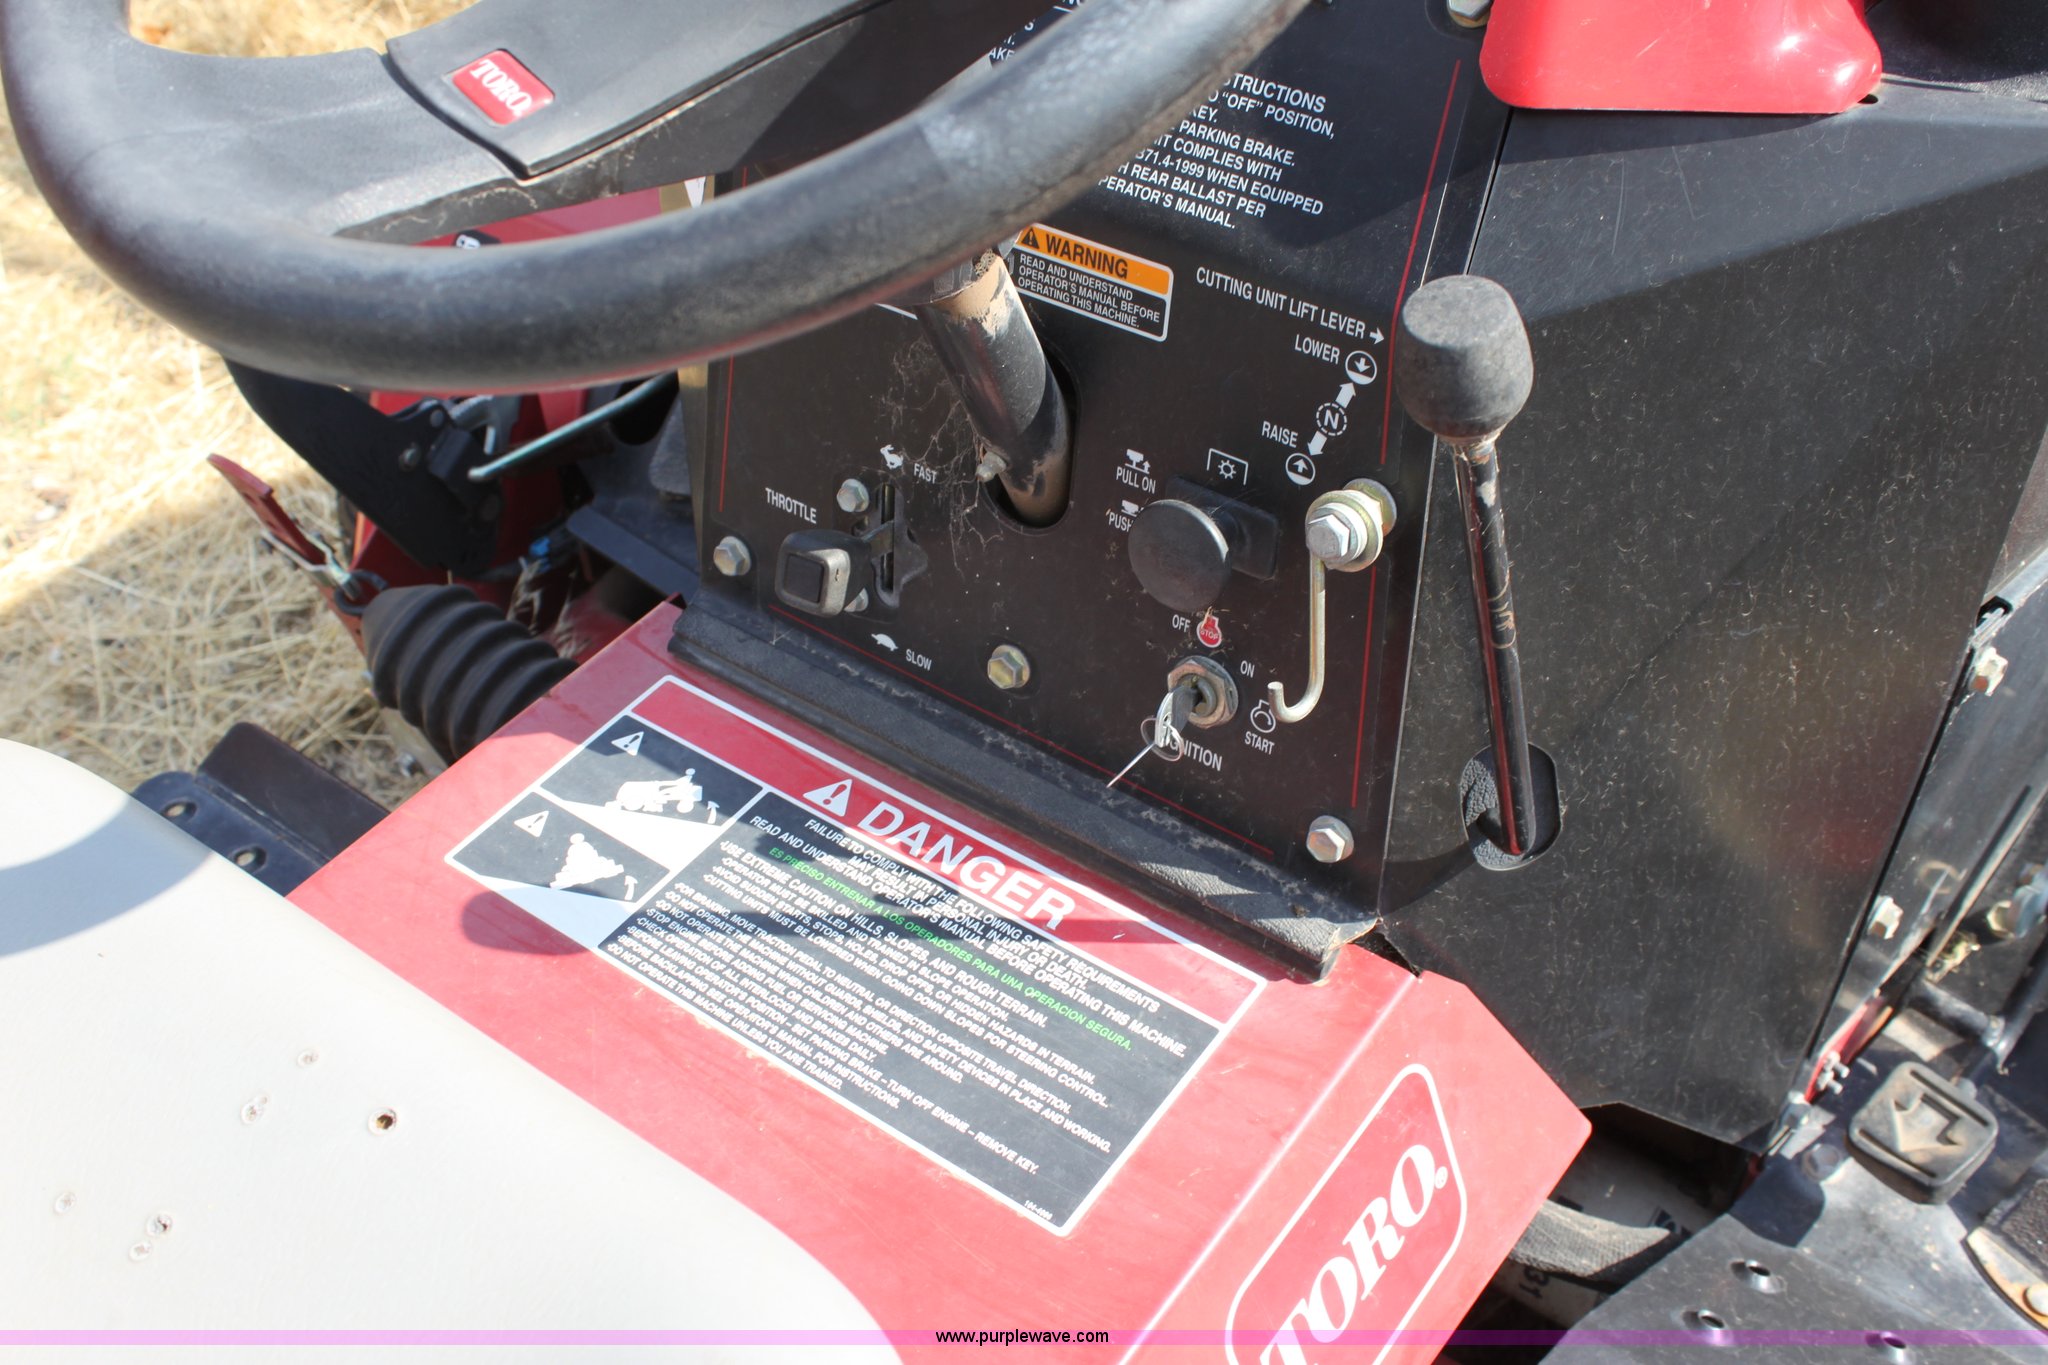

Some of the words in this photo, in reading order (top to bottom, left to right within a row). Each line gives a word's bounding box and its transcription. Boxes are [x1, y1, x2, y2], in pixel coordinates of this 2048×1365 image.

[470, 59, 532, 116] TORO
[1179, 120, 1241, 150] PARKING
[1243, 138, 1295, 166] BRAKE.
[1264, 104, 1334, 140] POSITION,
[1173, 137, 1244, 170] COMPLIES
[1246, 158, 1282, 182] WITH
[1130, 164, 1169, 187] REAR
[1171, 176, 1236, 207] BALLAST
[1236, 197, 1266, 218] PER
[1175, 197, 1236, 229] MANUAL.
[1206, 166, 1249, 192] WHEN
[1250, 181, 1324, 215] EQUIPPED
[1020, 253, 1045, 270] READ
[1047, 263, 1067, 278] AND
[1069, 271, 1133, 301] UNDERSTAND
[1045, 233, 1128, 279] WARNING
[1018, 276, 1070, 303] OPERATING
[1071, 295, 1092, 311] THIS
[1093, 302, 1140, 328] MACHINE.
[1019, 265, 1077, 292] OPERATOR'S
[1078, 286, 1118, 309] MANUAL
[1120, 301, 1160, 323] BEFORE
[1196, 266, 1252, 300] CUTTING
[1255, 286, 1287, 311] UNIT
[1288, 298, 1318, 322] LIFT
[1320, 308, 1366, 339] LEVER
[1294, 334, 1340, 365] LOWER
[1261, 421, 1298, 448] RAISE
[1323, 409, 1339, 430] N
[914, 463, 938, 484] FAST
[1116, 466, 1139, 488] PULL
[1141, 476, 1156, 494] ON
[765, 487, 817, 524] THROTTLE
[1172, 614, 1191, 633] OFF
[906, 649, 932, 671] SLOW
[1240, 660, 1255, 678] ON
[1245, 731, 1275, 755] START
[857, 801, 1075, 931] DANGER
[740, 851, 791, 884] EXTREME
[787, 877, 837, 910] CAUTION
[832, 902, 853, 919] ON
[850, 912, 886, 937] HILLS,
[883, 930, 932, 963] SLOPES,
[929, 955, 957, 976] AND
[953, 969, 998, 999] ROUGH
[994, 991, 1049, 1028] TERRAIN.
[749, 815, 781, 837] READ
[778, 831, 804, 849] AND
[801, 843, 873, 887] UNDERSTAND
[870, 880, 941, 923] OPERATOR'S
[938, 917, 989, 949] MANUAL
[985, 942, 1035, 975] BEFORE
[1033, 968, 1102, 1011] OPERATING
[1099, 1003, 1130, 1026] THIS
[1127, 1019, 1188, 1058] MACHINE.
[768, 882, 795, 901] MUST
[793, 896, 809, 909] BE
[807, 904, 847, 930] SKILLED
[846, 926, 868, 942] AND
[866, 936, 908, 965] TRAINED
[906, 959, 919, 971] IN
[918, 965, 952, 989] SLOPE
[804, 818, 850, 847] FAILURE
[845, 840, 865, 855] TO
[861, 848, 907, 878] COMPLY
[905, 871, 935, 893] WITH
[931, 885, 958, 905] THE
[954, 898, 1022, 940] FOLLOWING
[1021, 933, 1068, 964] SAFETY
[1065, 957, 1160, 1013] REQUIREMENTS
[848, 855, 873, 873] MAY
[871, 867, 916, 896] RESULT
[912, 889, 928, 903] IN
[925, 896, 987, 934] PERSONAL
[985, 928, 1028, 957] INJURY
[1026, 950, 1047, 967] OR
[1045, 960, 1089, 990] DEATH.
[738, 879, 778, 906] SUDDEN
[878, 957, 908, 979] DROP
[934, 989, 952, 1004] OR
[950, 998, 989, 1025] HIDDEN
[987, 1019, 1037, 1052] HAZARDS
[1035, 1046, 1050, 1059] IN
[768, 846, 783, 859] ES
[782, 854, 824, 881] PRECISO
[822, 876, 876, 909] ENTRENAR
[873, 903, 884, 914] A
[882, 908, 905, 925] LOS
[904, 920, 973, 963] OPERADORES
[971, 957, 1001, 978] PARA
[1000, 972, 1024, 991] UNA
[1023, 985, 1086, 1025] OPERACION
[1085, 1019, 1134, 1051] SEGURA.
[619, 950, 640, 966] NOT
[637, 961, 677, 989] OPERATE
[673, 983, 695, 1000] THIS
[692, 994, 733, 1023] MACHINE
[730, 1017, 767, 1043] UNLESS
[764, 1037, 785, 1054] YOU
[783, 1048, 804, 1066] ARE
[729, 913, 755, 932] MOVE
[752, 926, 796, 956] TRACTION
[793, 950, 824, 972] PEDAL
[821, 966, 836, 979] TO
[833, 973, 876, 1002] NEUTRAL
[874, 996, 891, 1010] OR
[888, 1004, 938, 1038] DIRECTION
[936, 1031, 984, 1064] OPPOSITE
[981, 1057, 1019, 1084] TRAVEL
[740, 894, 770, 915] UNITS
[767, 909, 795, 930] MUST
[793, 924, 809, 937] BE
[807, 932, 855, 963] LOWERED
[851, 957, 883, 979] WHEN
[880, 973, 914, 997] GOING
[912, 991, 945, 1015] DOWN
[943, 1008, 985, 1037] SLOPES
[983, 1031, 1007, 1050] FOR
[1005, 1043, 1058, 1079] STEERING
[1260, 1144, 1440, 1365] TORO
